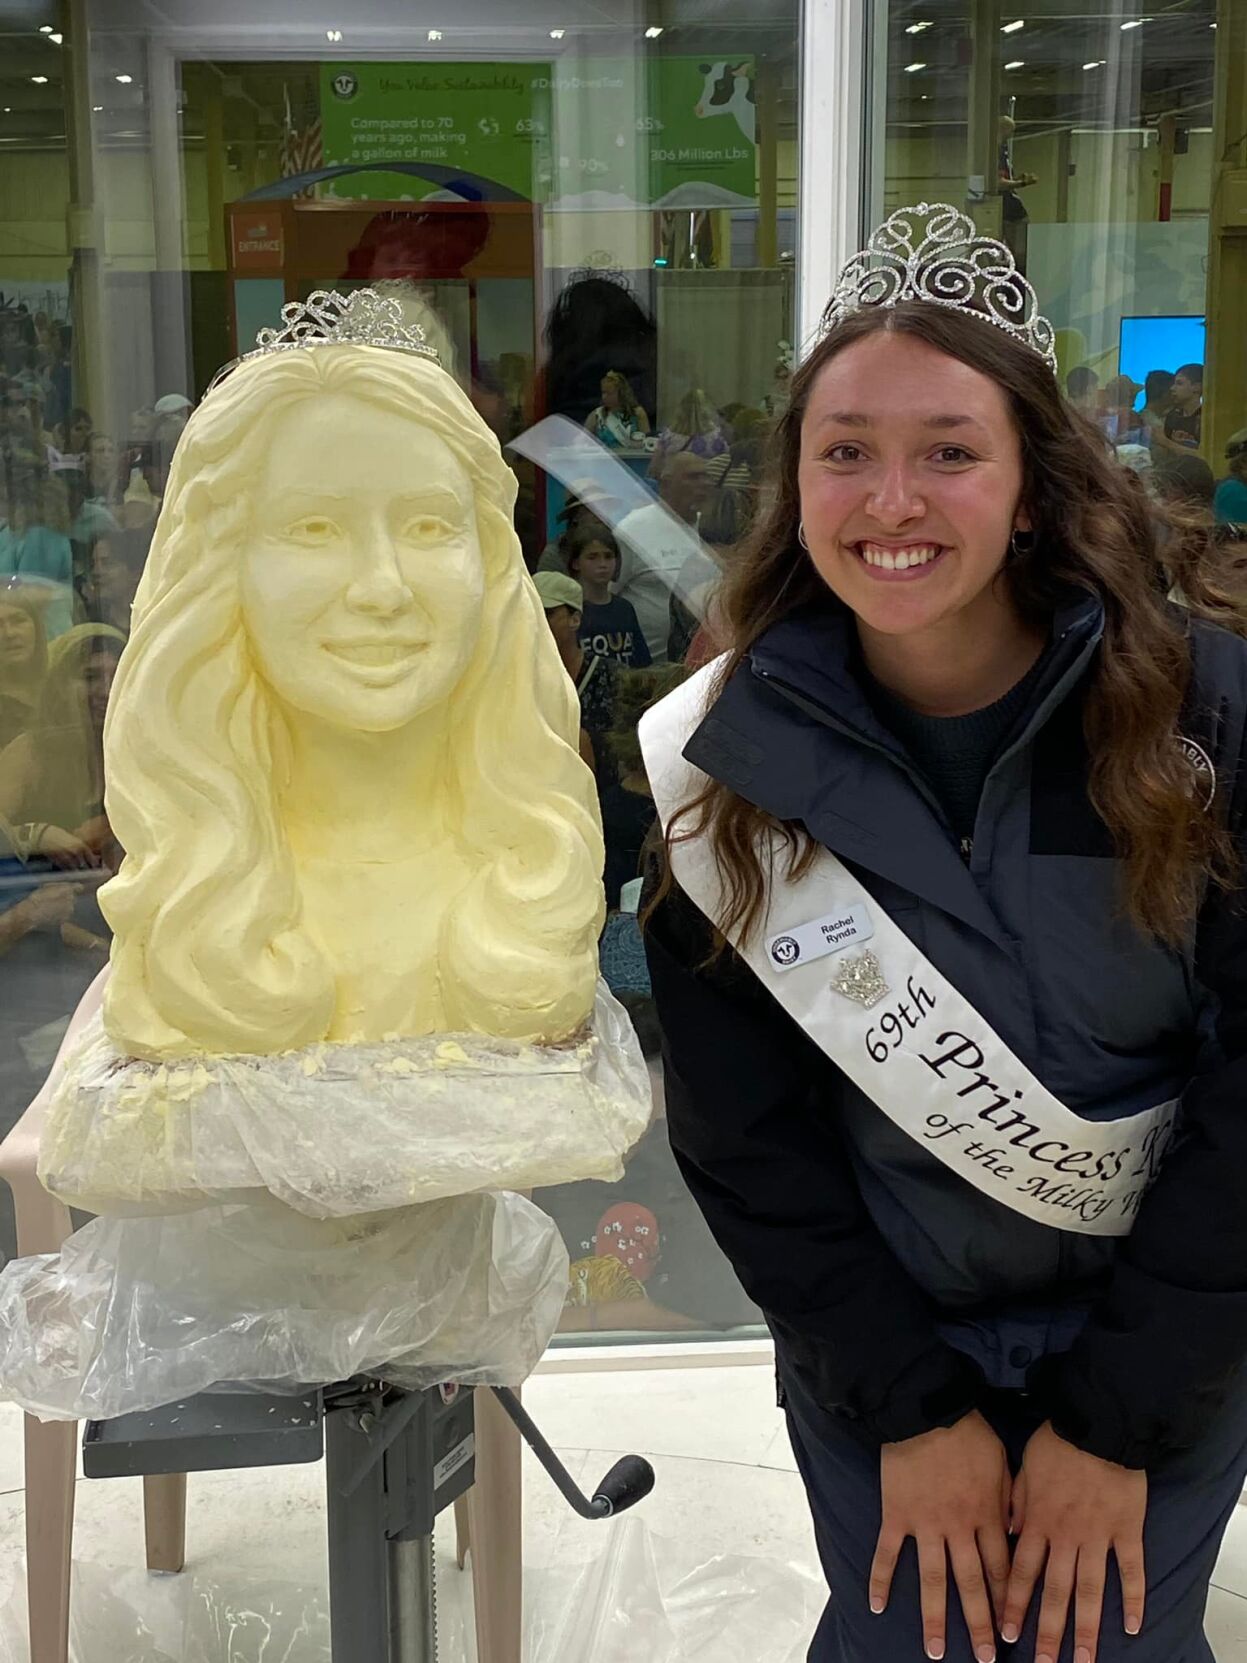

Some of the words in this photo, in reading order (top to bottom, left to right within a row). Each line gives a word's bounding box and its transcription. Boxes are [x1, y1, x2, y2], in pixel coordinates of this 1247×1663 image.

[351, 117, 418, 132] Compared
[421, 119, 435, 129] to
[437, 117, 453, 128] 70
[352, 133, 387, 144] years
[420, 131, 466, 145] making
[351, 150, 360, 159] a
[362, 147, 402, 161] gallon
[404, 147, 418, 159] of
[420, 147, 448, 159] milk
[679, 147, 722, 160] Million
[725, 146, 749, 159] Lbs
[820, 915, 855, 935] Rachel
[826, 927, 857, 944] Rynda
[866, 975, 936, 1063] 69th
[918, 1031, 1131, 1181] Princess
[923, 1114, 975, 1139] of
[963, 1141, 1015, 1180] the
[1016, 1177, 1115, 1222] Milky
